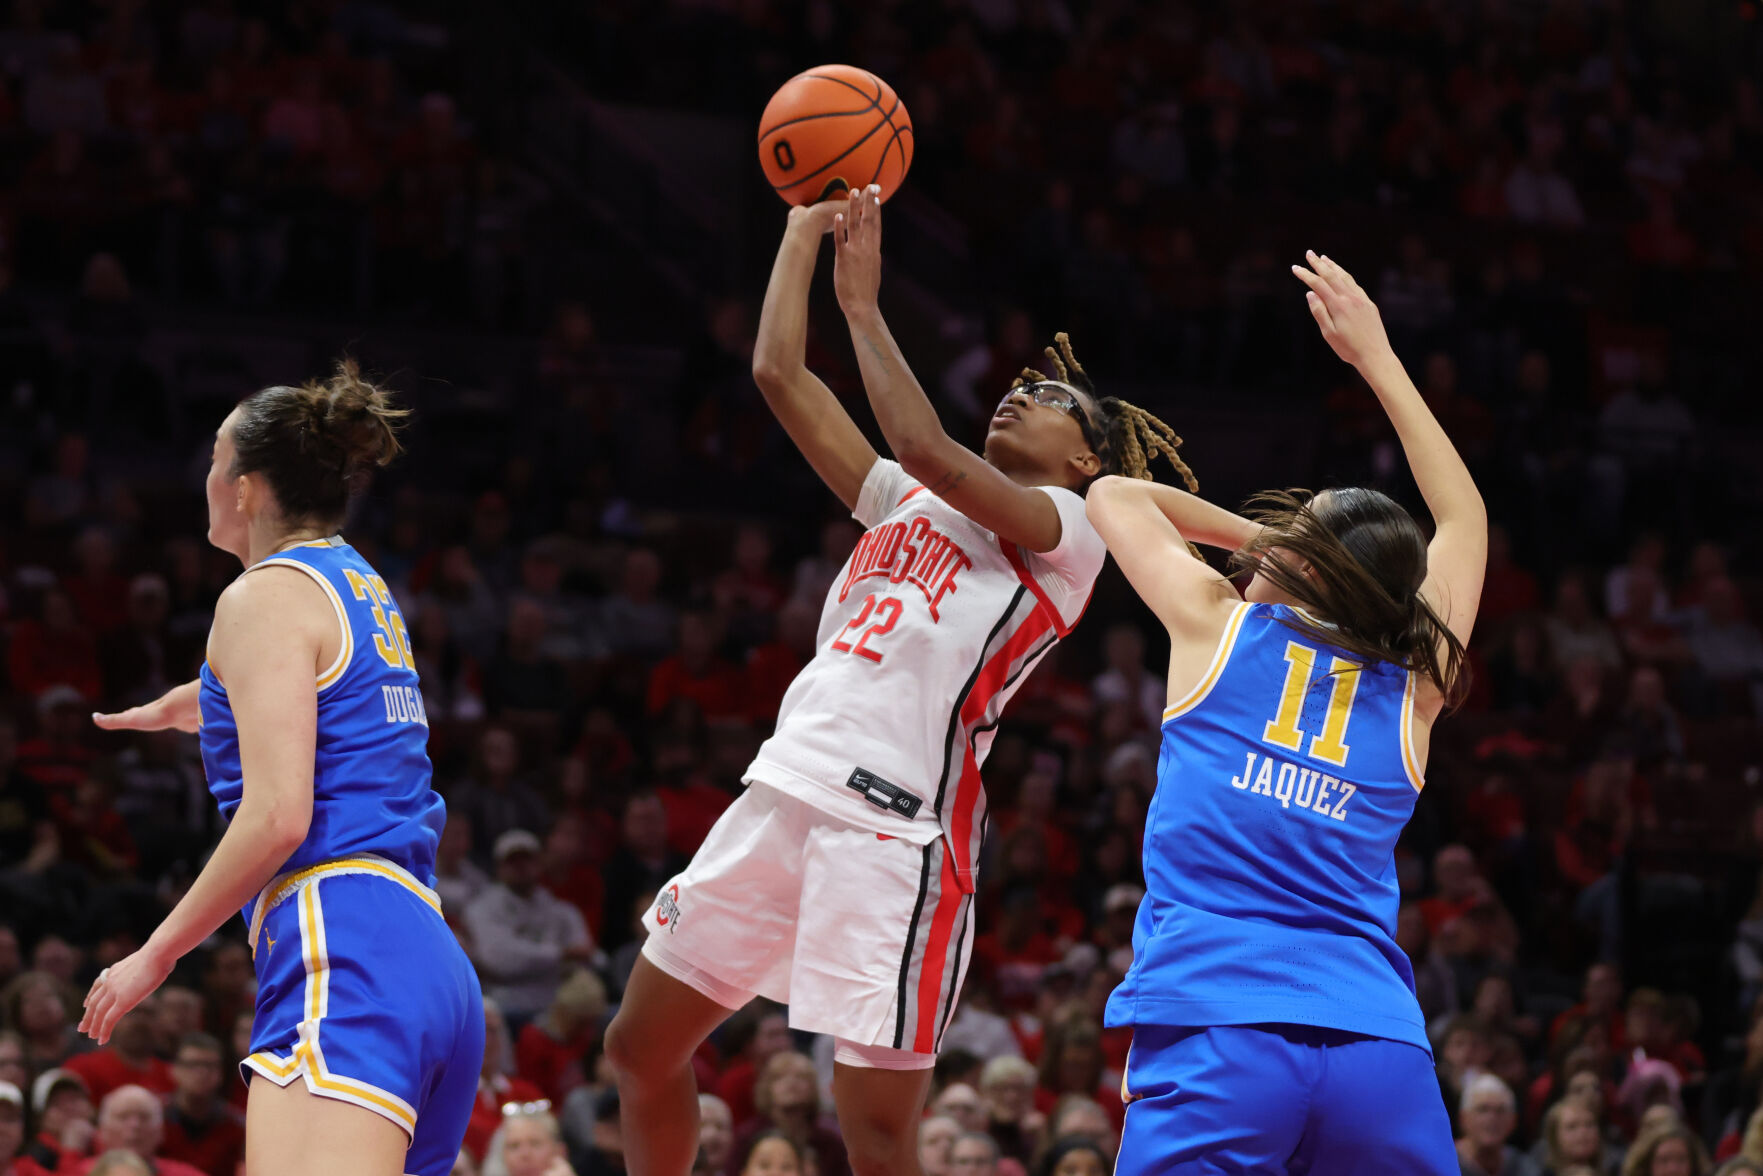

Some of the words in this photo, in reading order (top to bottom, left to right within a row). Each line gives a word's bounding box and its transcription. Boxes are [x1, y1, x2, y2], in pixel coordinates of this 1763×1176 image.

[341, 568, 418, 674] 32
[831, 594, 904, 664] 22
[1262, 640, 1364, 768] 11
[897, 797, 910, 809] 40
[1231, 752, 1357, 822] JAQUEZ
